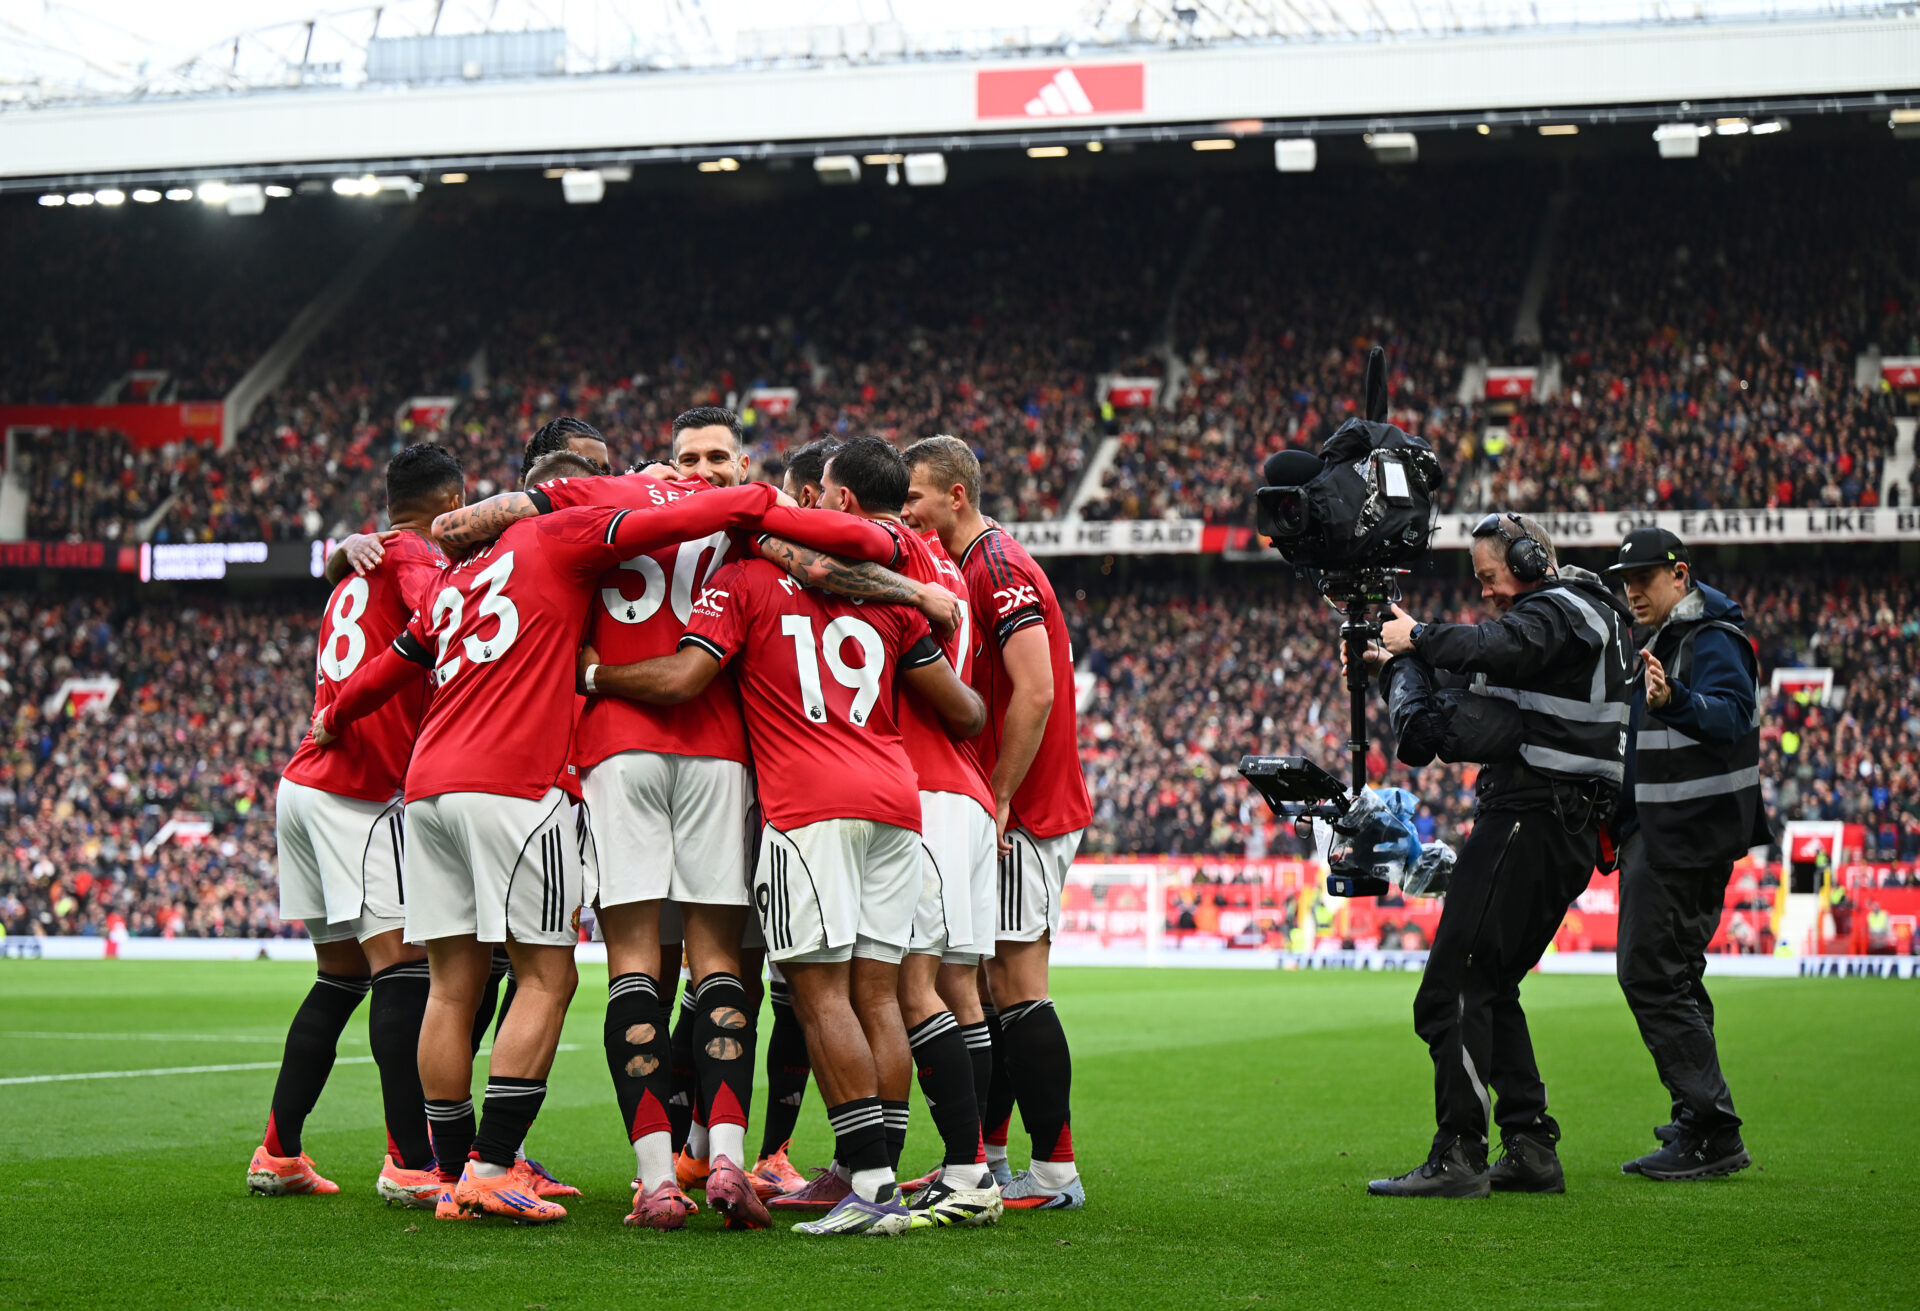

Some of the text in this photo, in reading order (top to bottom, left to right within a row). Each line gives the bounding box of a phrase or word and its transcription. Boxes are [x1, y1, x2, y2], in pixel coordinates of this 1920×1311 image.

[1130, 526, 1193, 543] SAID
[1681, 510, 1784, 534] EARTH
[1808, 509, 1875, 533] LIKE
[601, 530, 732, 626] 30
[693, 588, 730, 612] XC
[432, 550, 520, 688] 23
[781, 614, 886, 728] 19
